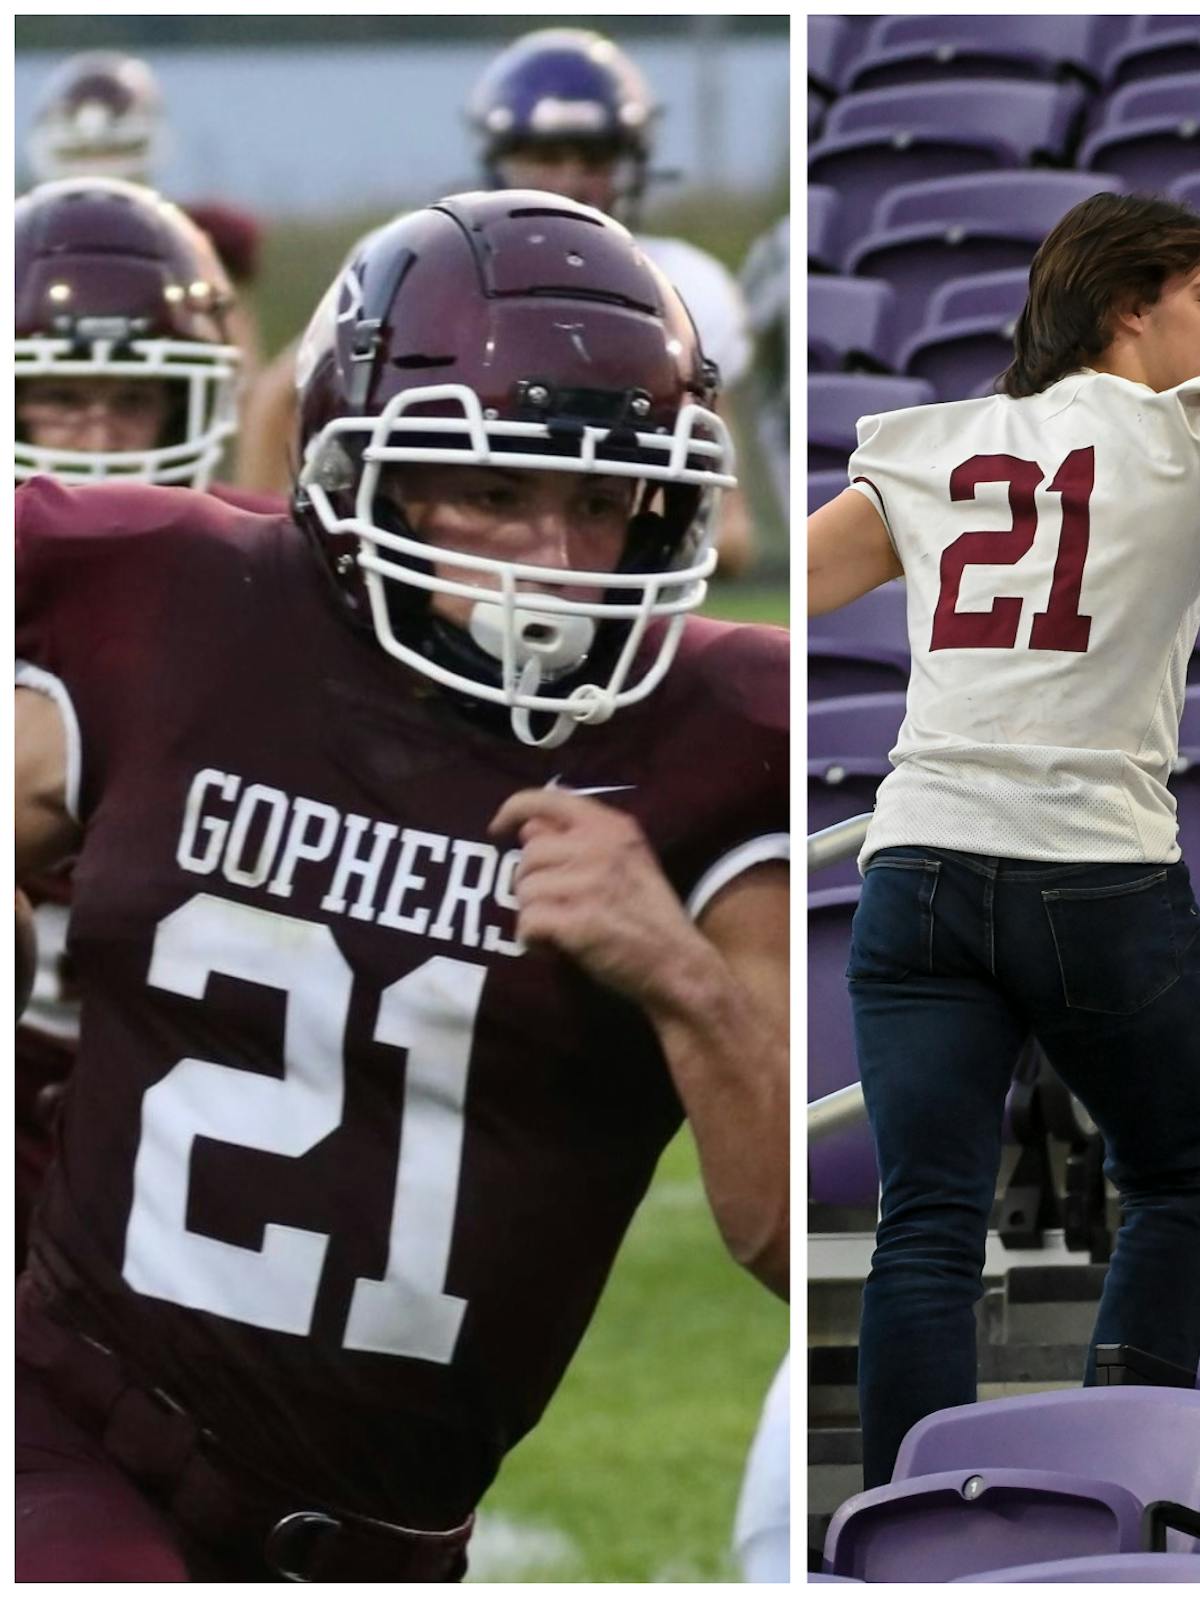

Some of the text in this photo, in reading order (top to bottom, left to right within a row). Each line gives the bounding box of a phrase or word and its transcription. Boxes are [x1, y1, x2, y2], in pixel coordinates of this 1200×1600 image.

[930, 446, 1094, 651] 21
[176, 768, 527, 957] GOPHERS
[122, 893, 487, 1364] 21
